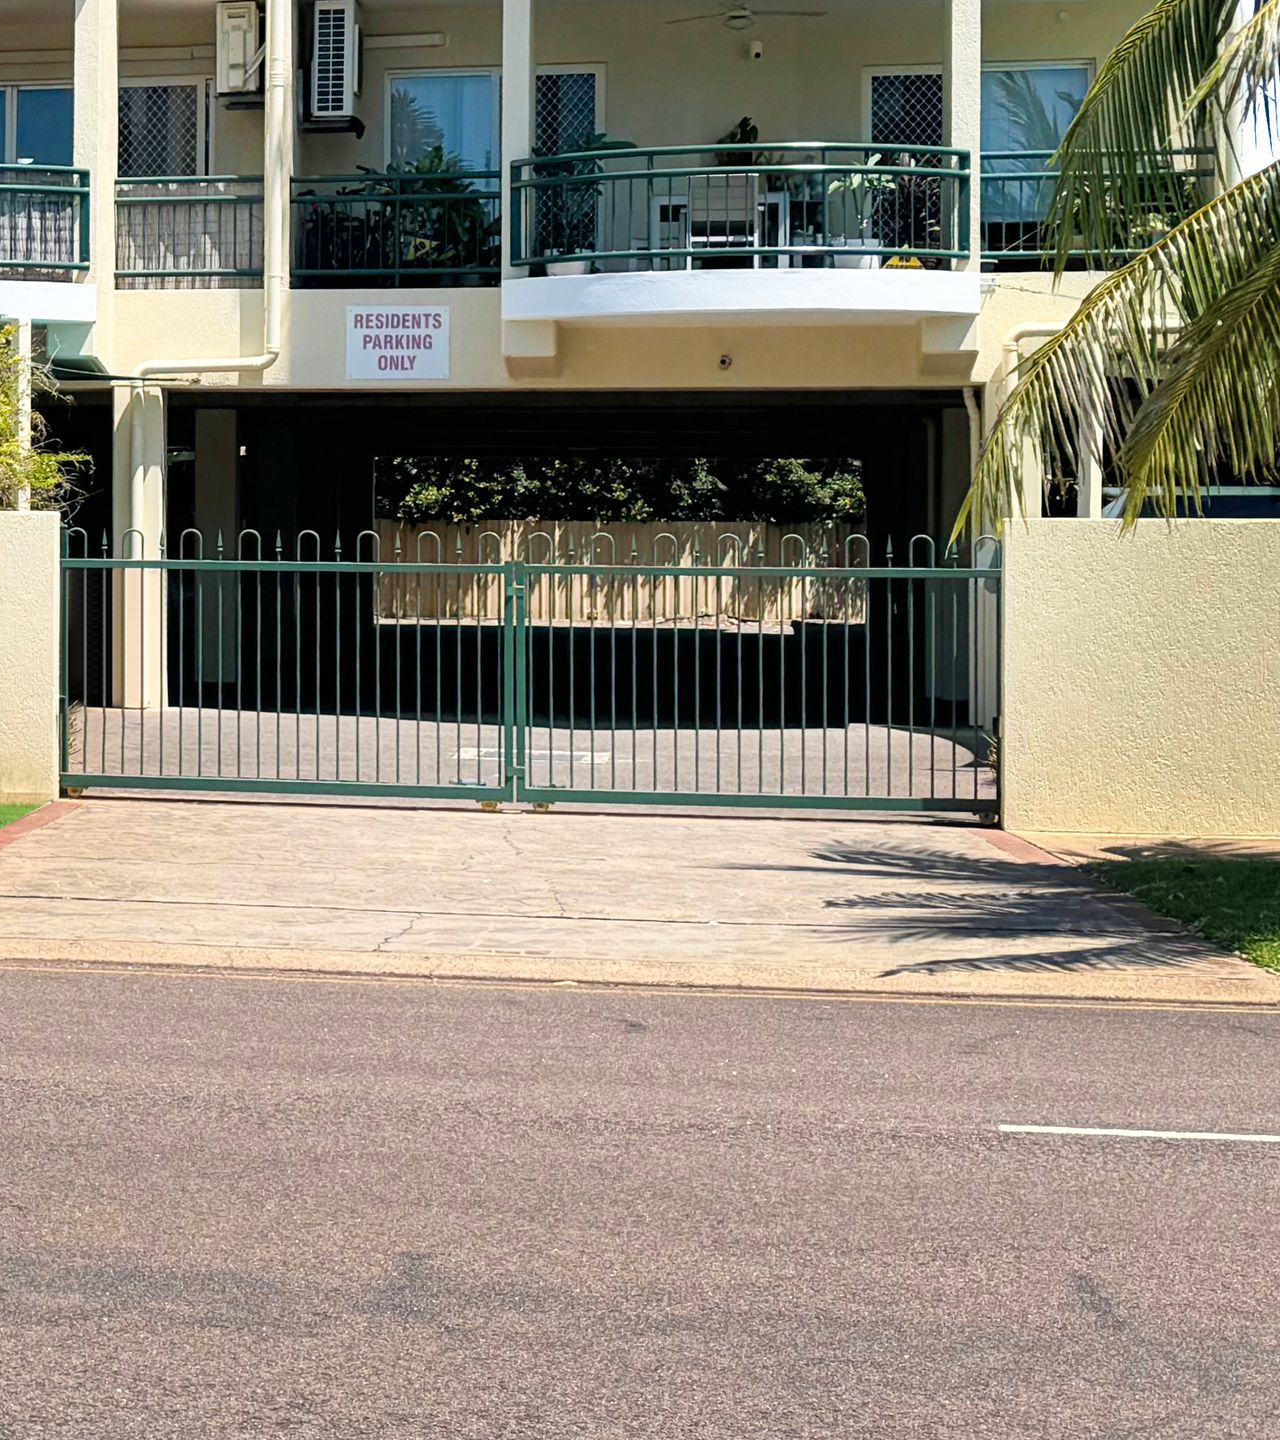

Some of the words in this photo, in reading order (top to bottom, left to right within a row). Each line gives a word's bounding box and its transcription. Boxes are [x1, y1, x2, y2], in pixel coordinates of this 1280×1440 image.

[353, 313, 442, 329] RESIDENTS
[362, 334, 433, 350] PARKING
[377, 355, 417, 371] ONLY
